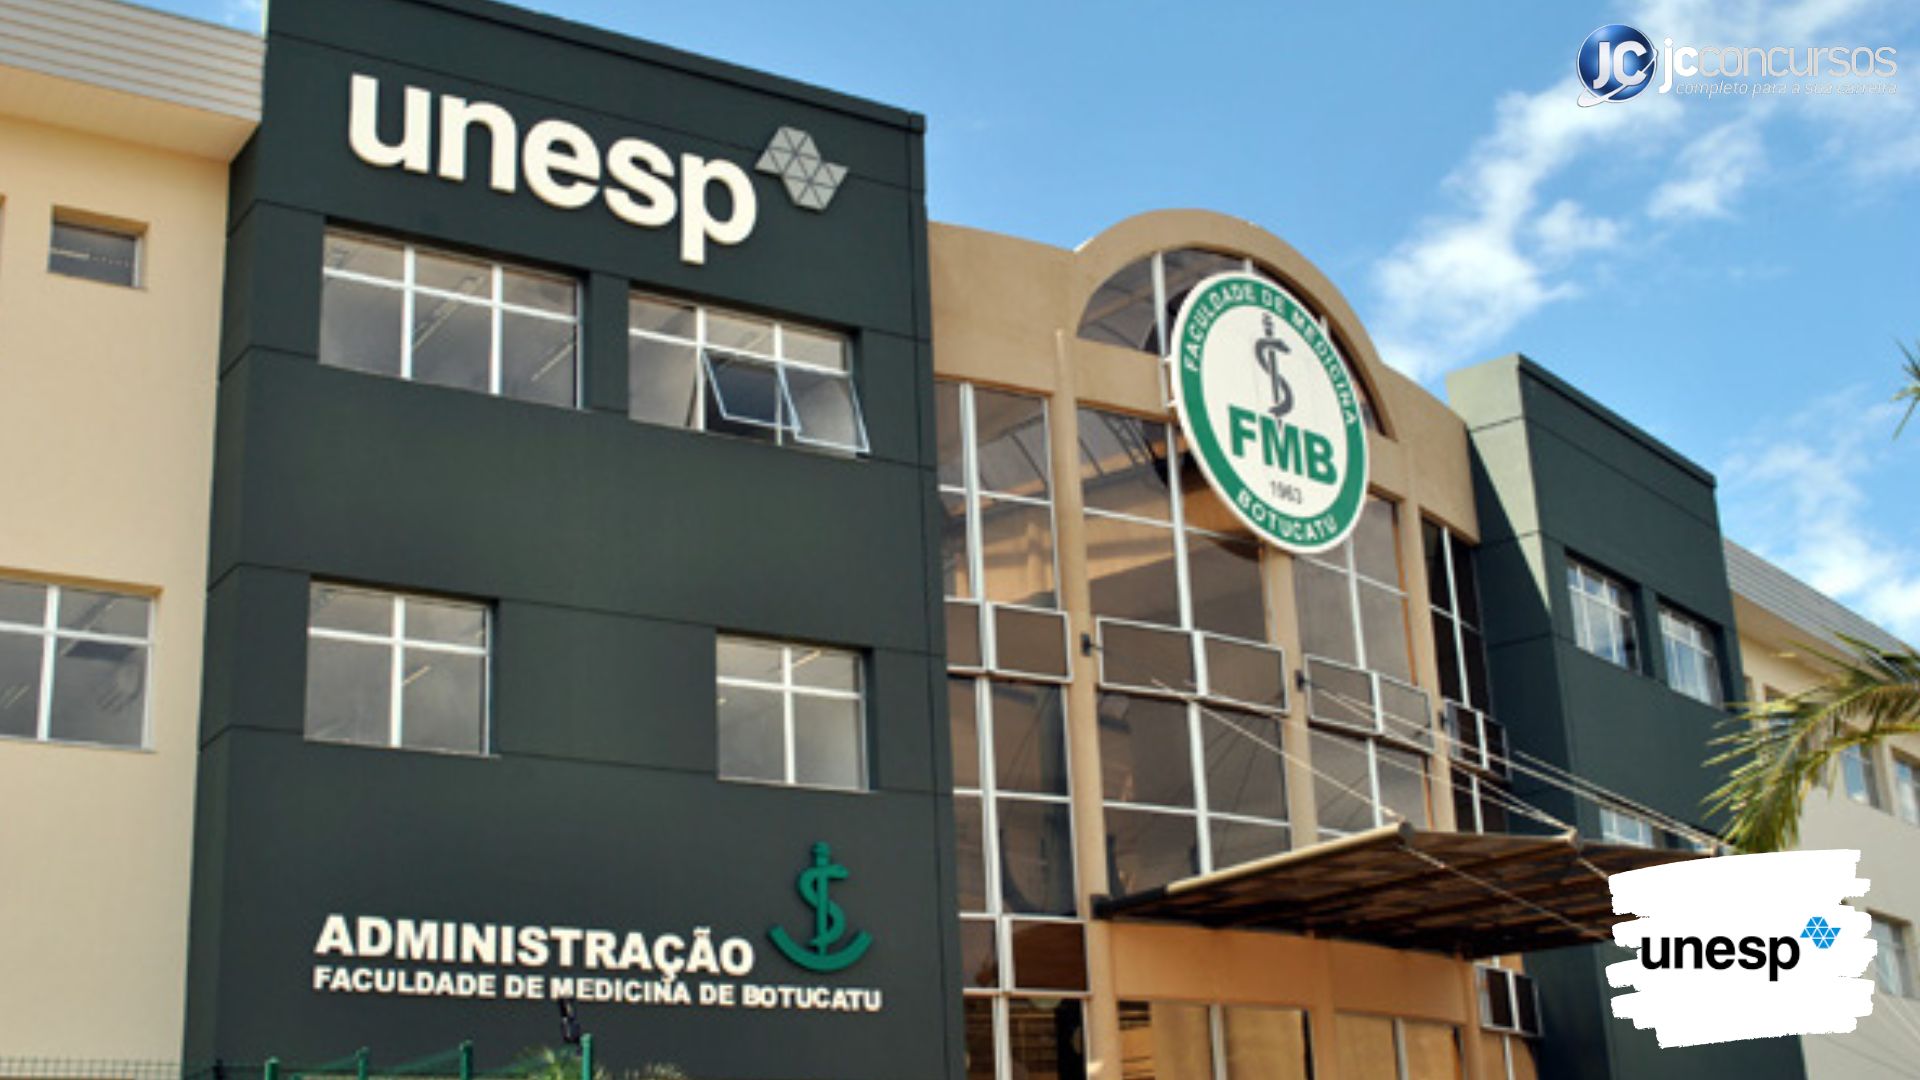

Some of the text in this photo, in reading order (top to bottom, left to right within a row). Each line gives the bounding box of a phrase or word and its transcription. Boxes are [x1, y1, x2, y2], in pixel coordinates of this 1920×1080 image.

[349, 73, 757, 265] unesp
[1184, 284, 1358, 424] FACULDADE DE MEDICINA
[1228, 404, 1338, 486] FMB
[1238, 489, 1338, 541] BOTUCATU
[314, 914, 755, 980] ADMINISTRAÇÃO
[313, 966, 883, 1012] FACULDADE DE MEDICINA DE BOTUCATU
